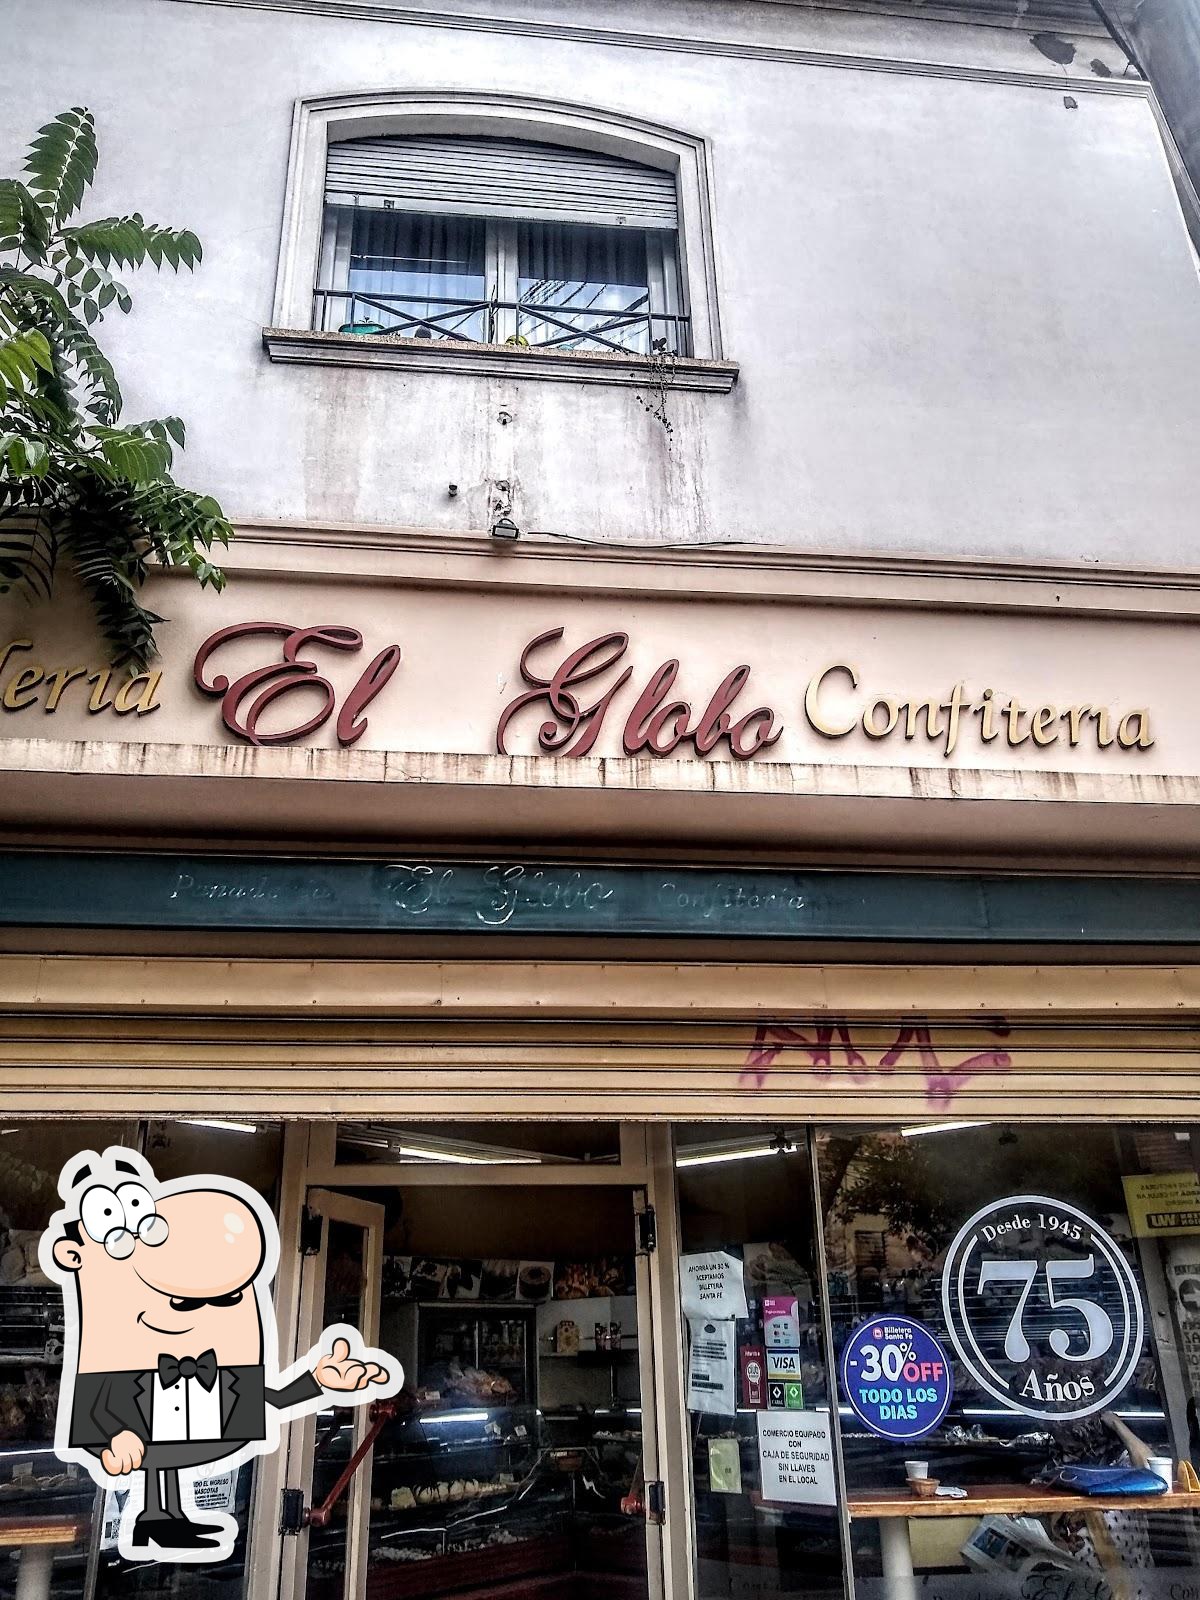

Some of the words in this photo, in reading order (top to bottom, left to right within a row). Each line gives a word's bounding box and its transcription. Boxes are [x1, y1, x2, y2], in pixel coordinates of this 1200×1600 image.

[0, 640, 163, 718] eria
[193, 620, 402, 747] El
[497, 627, 783, 761] Globo
[804, 664, 1155, 758] Confiteria
[981, 1214, 1031, 1243] Desde
[1038, 1213, 1083, 1240] 1945
[976, 1253, 1114, 1364] 75
[770, 1356, 796, 1369] VISA
[903, 1362, 943, 1383] OFF
[1019, 1369, 1095, 1402] Años
[859, 1388, 903, 1404] TODO
[906, 1387, 938, 1403] LOS
[879, 1404, 918, 1420] DIAS
[762, 1429, 794, 1438] COMERCIO
[795, 1430, 826, 1439] EQUIPADO
[788, 1440, 802, 1448] CON
[762, 1450, 779, 1459] CAJA
[781, 1451, 790, 1459] DE
[791, 1451, 830, 1462] SEGURIDAD
[778, 1462, 789, 1471] SIN
[790, 1463, 816, 1473] LLAVES
[778, 1475, 787, 1483] EN
[788, 1475, 796, 1483] EL
[797, 1476, 818, 1485] LOCAL
